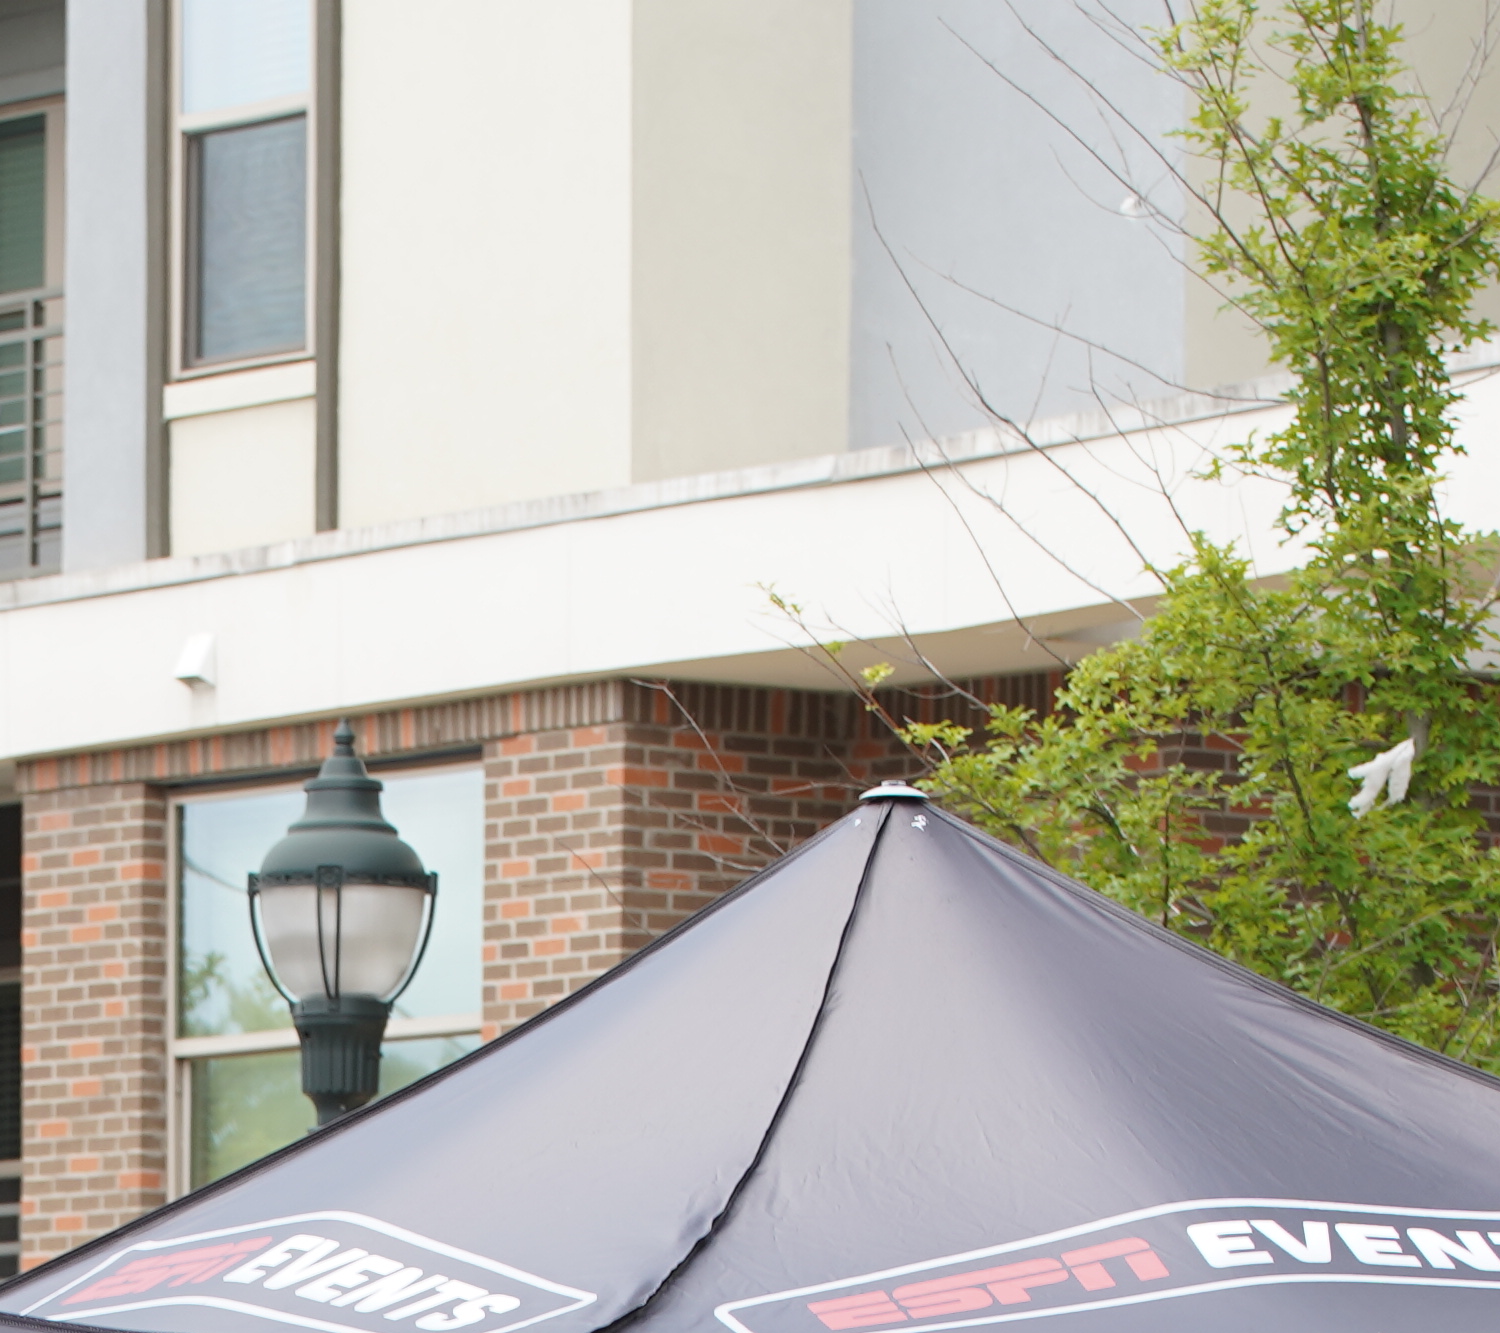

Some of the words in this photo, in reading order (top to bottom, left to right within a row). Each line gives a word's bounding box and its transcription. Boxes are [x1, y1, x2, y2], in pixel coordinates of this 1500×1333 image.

[62, 1236, 273, 1306] ESPN
[222, 1234, 521, 1332] EVENTS
[807, 1237, 1170, 1331] ESPN
